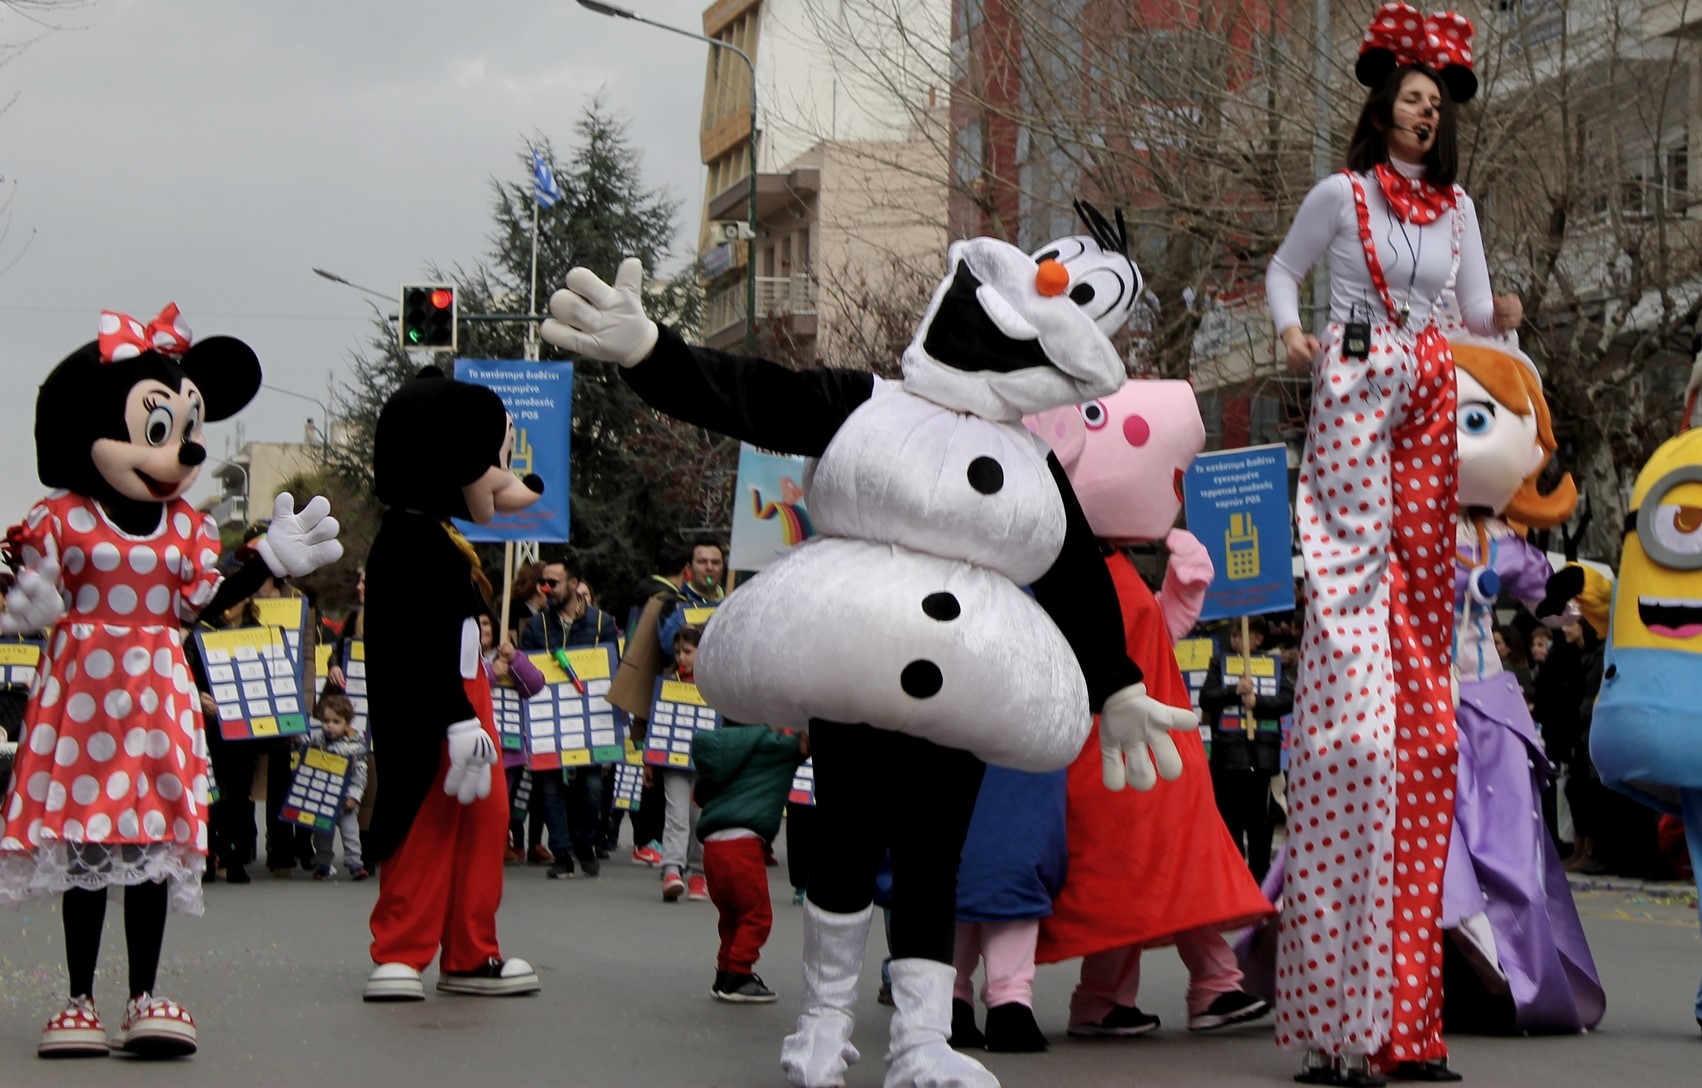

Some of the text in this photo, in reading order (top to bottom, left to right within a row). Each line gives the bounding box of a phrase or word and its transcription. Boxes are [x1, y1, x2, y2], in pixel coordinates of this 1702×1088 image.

[467, 368, 560, 382] Το κατάστημα διαθέτει
[514, 396, 555, 409] αποδοχής
[521, 410, 540, 421] POS
[1194, 455, 1276, 475] Το κατάστημα διαθέτει
